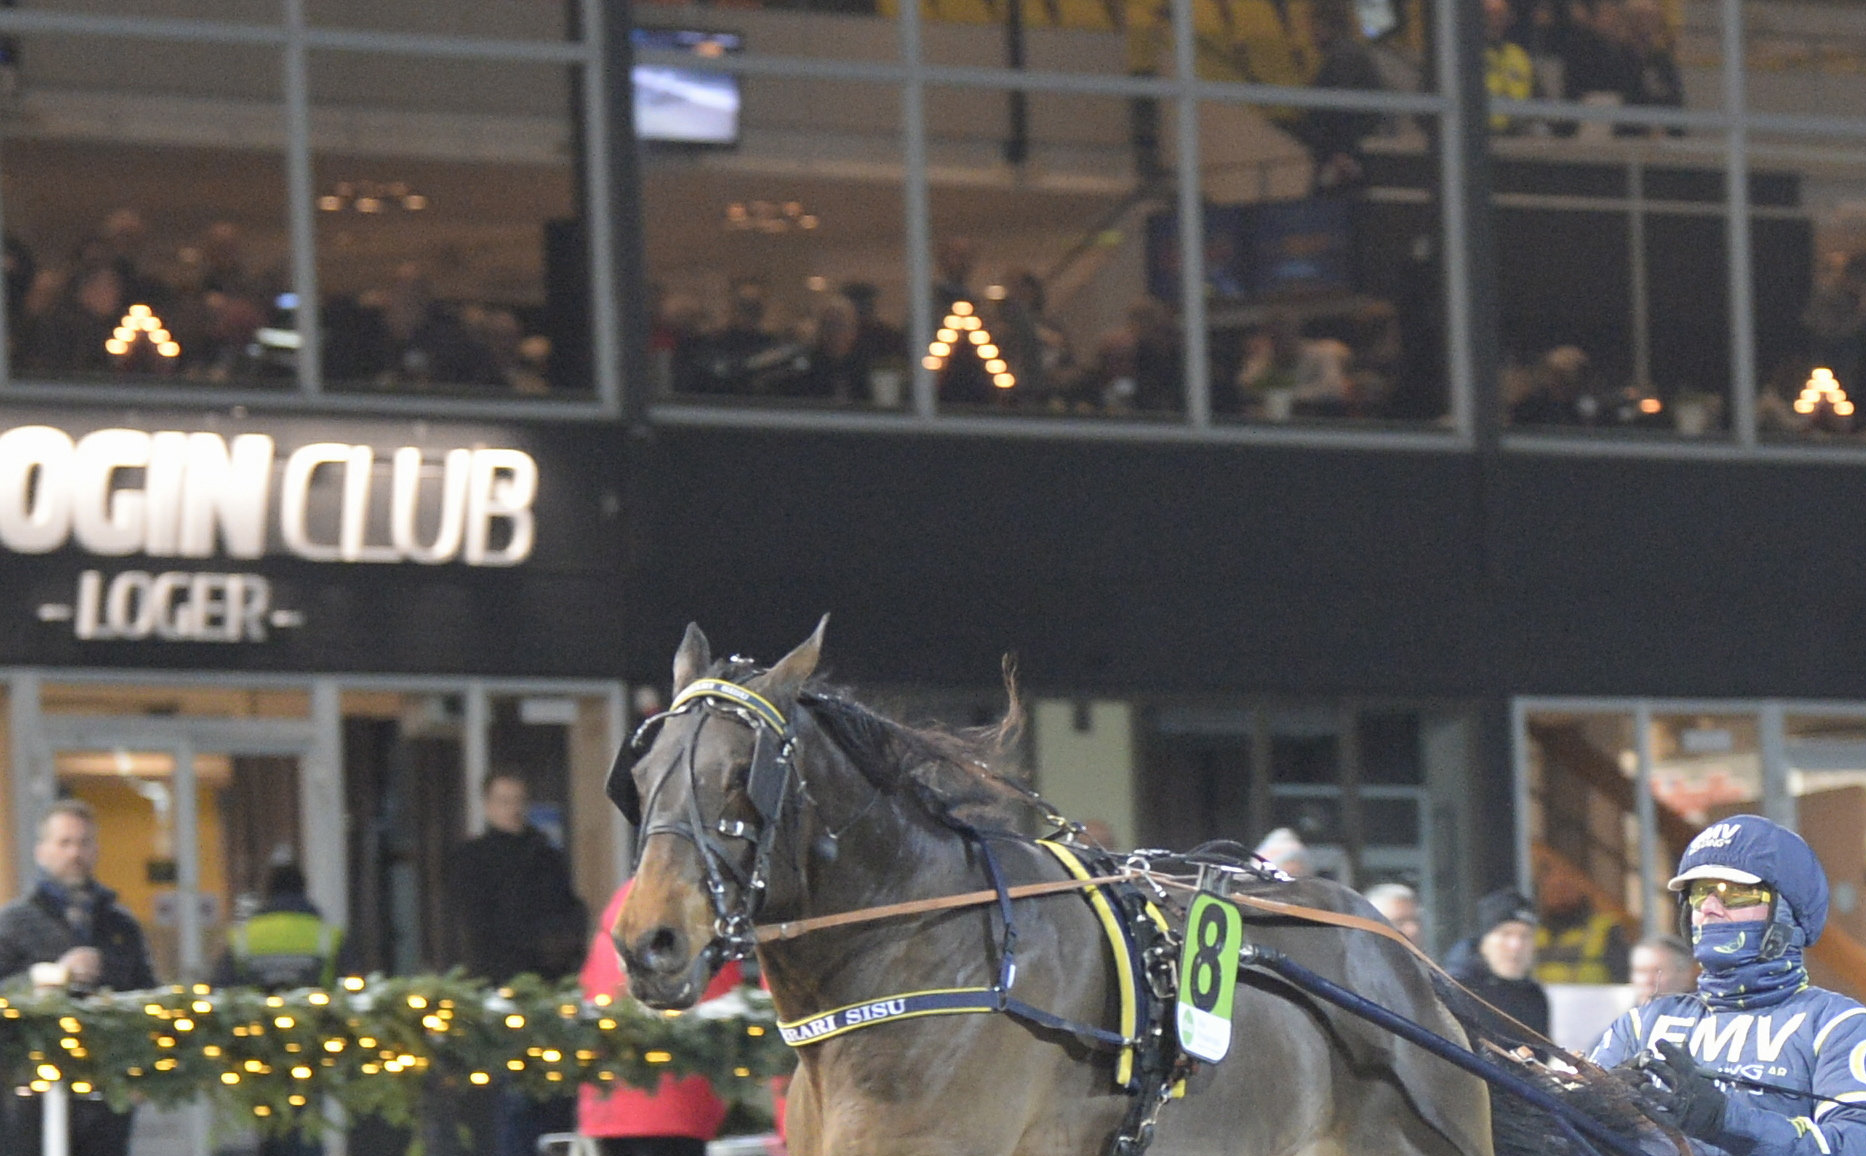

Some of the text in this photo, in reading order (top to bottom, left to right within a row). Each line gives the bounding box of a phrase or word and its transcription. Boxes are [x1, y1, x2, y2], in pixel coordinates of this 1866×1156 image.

[280, 442, 539, 567] CLUB
[845, 998, 906, 1026] SISU
[1190, 903, 1228, 1013] 8
